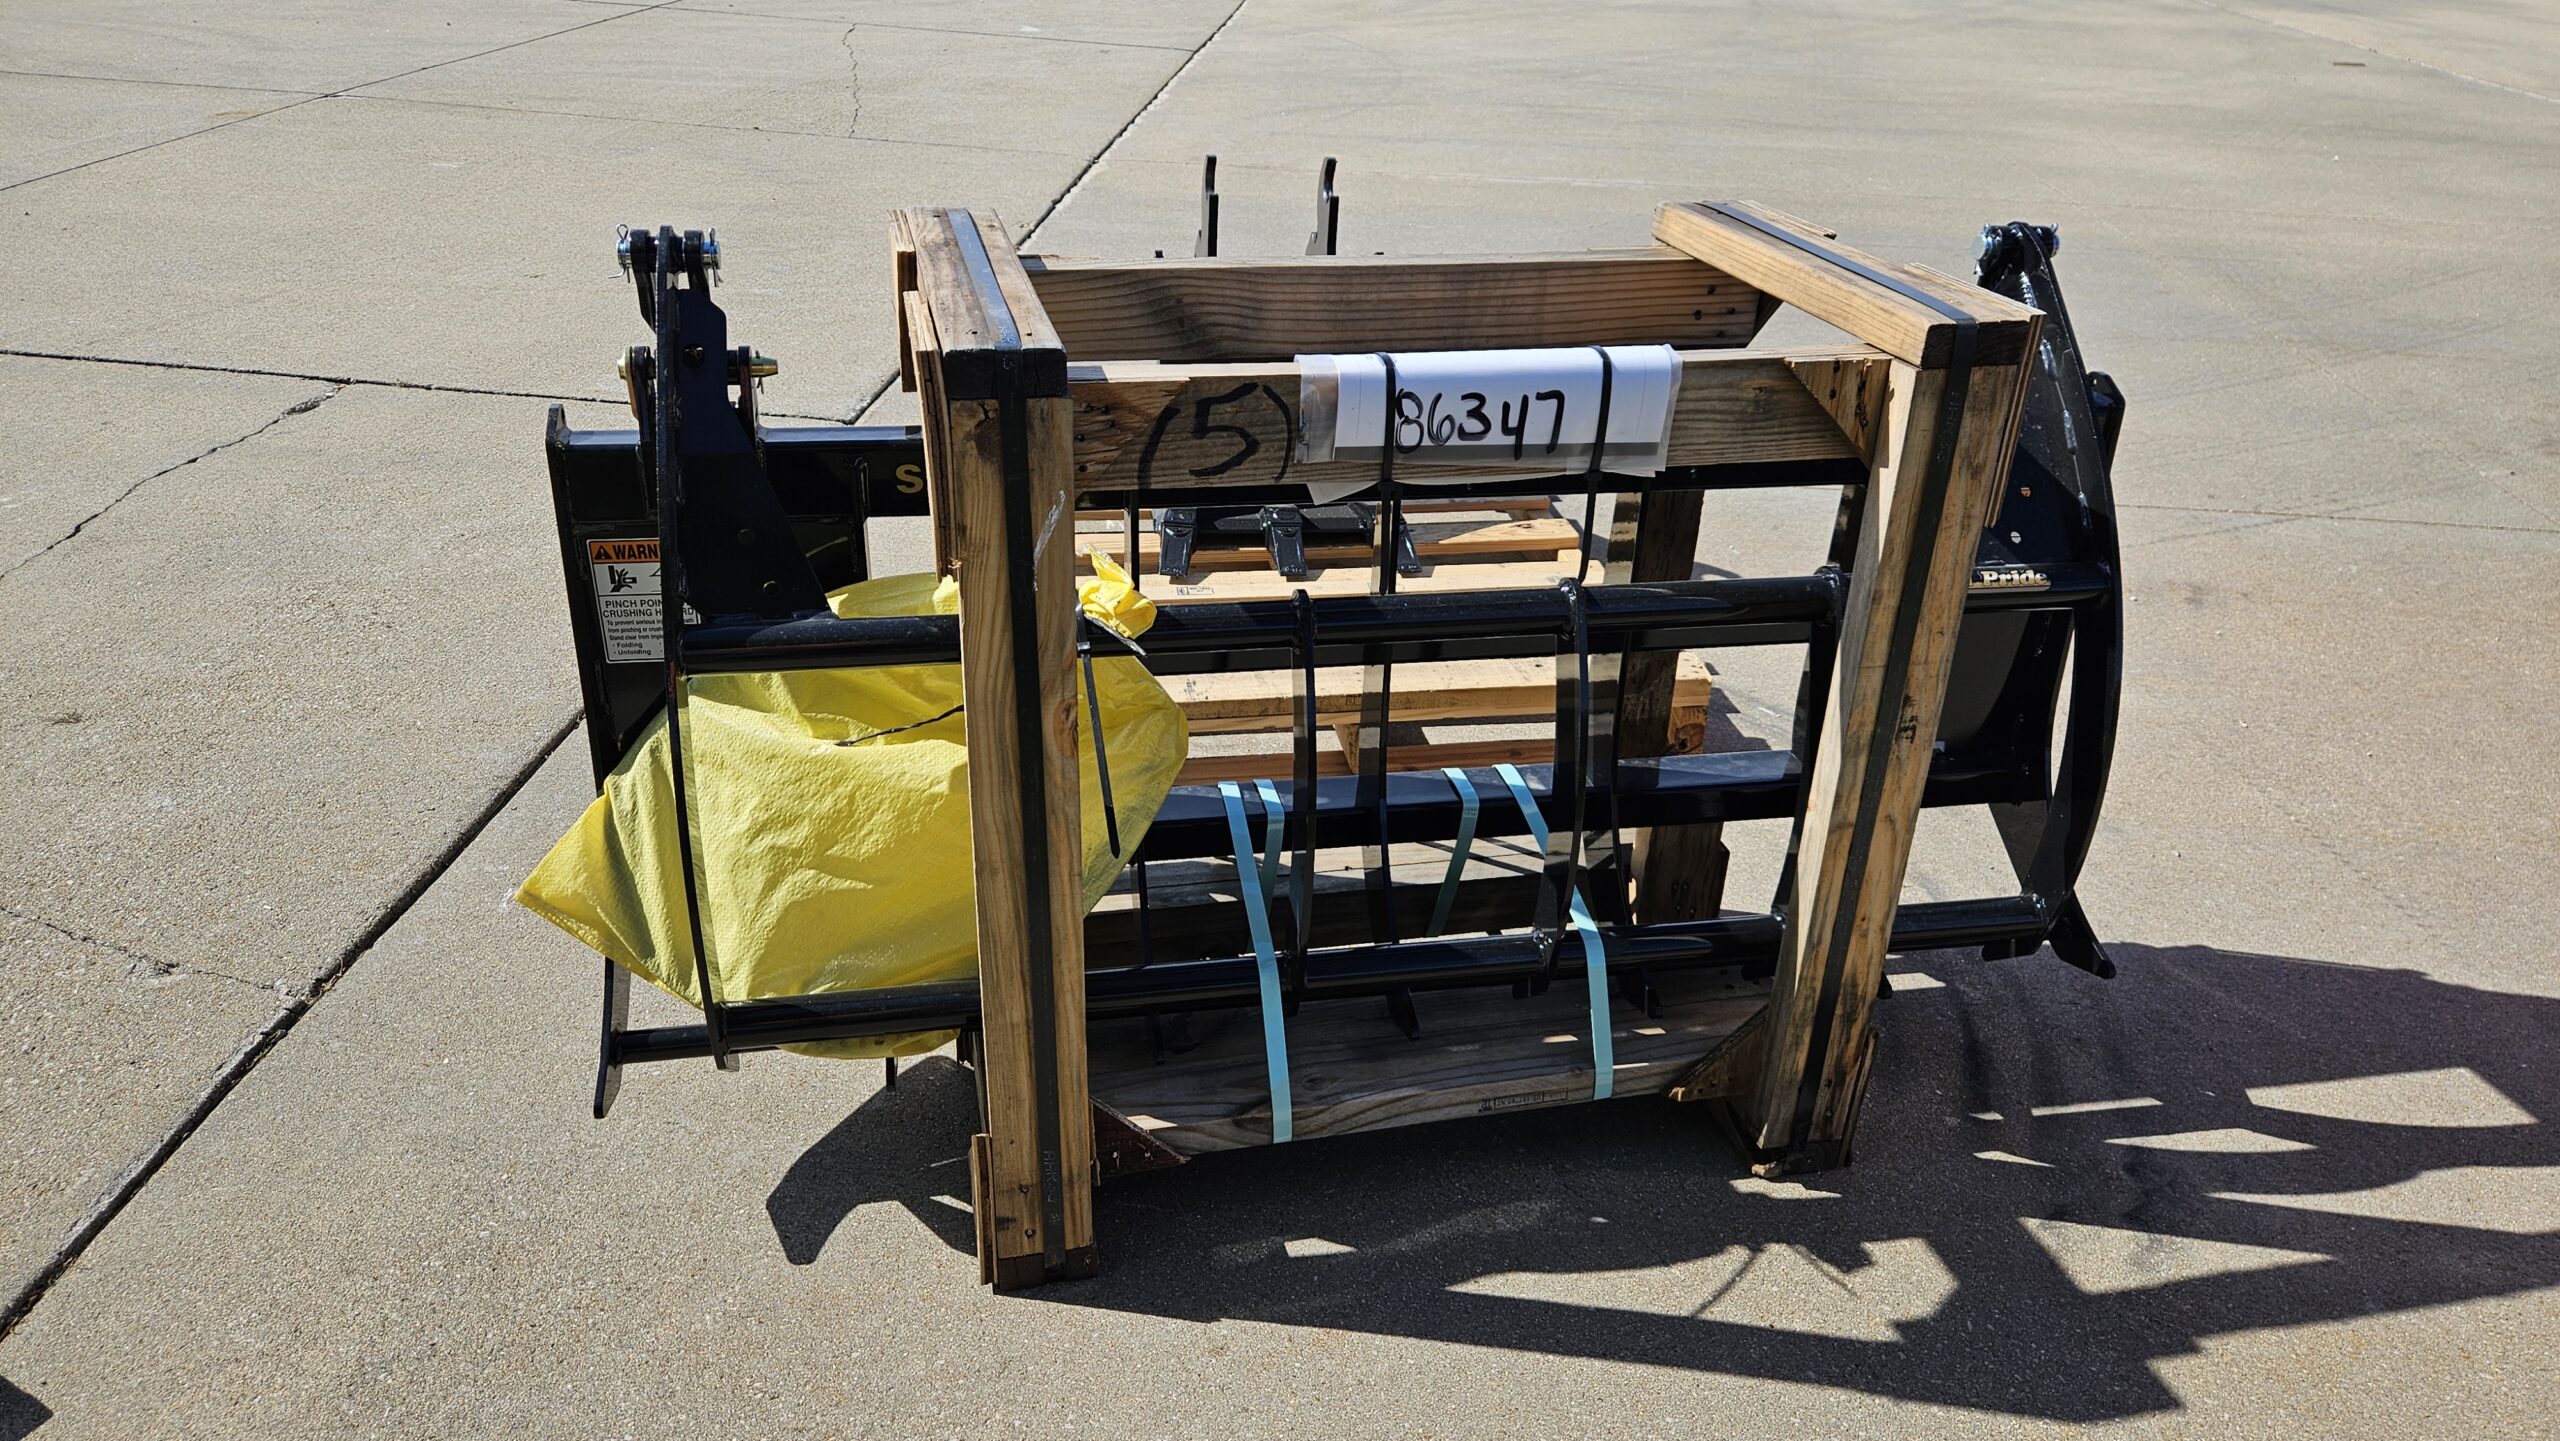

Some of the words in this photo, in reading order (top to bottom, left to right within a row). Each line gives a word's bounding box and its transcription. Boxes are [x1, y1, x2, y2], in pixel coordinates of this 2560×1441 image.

[1395, 388, 1565, 461] 86347
[896, 463, 924, 494] S
[612, 543, 660, 560] WARN
[1980, 569, 2049, 587] Pride
[605, 599, 638, 608] PINCH
[640, 598, 663, 608] POIN
[603, 608, 653, 618] CRUSHING
